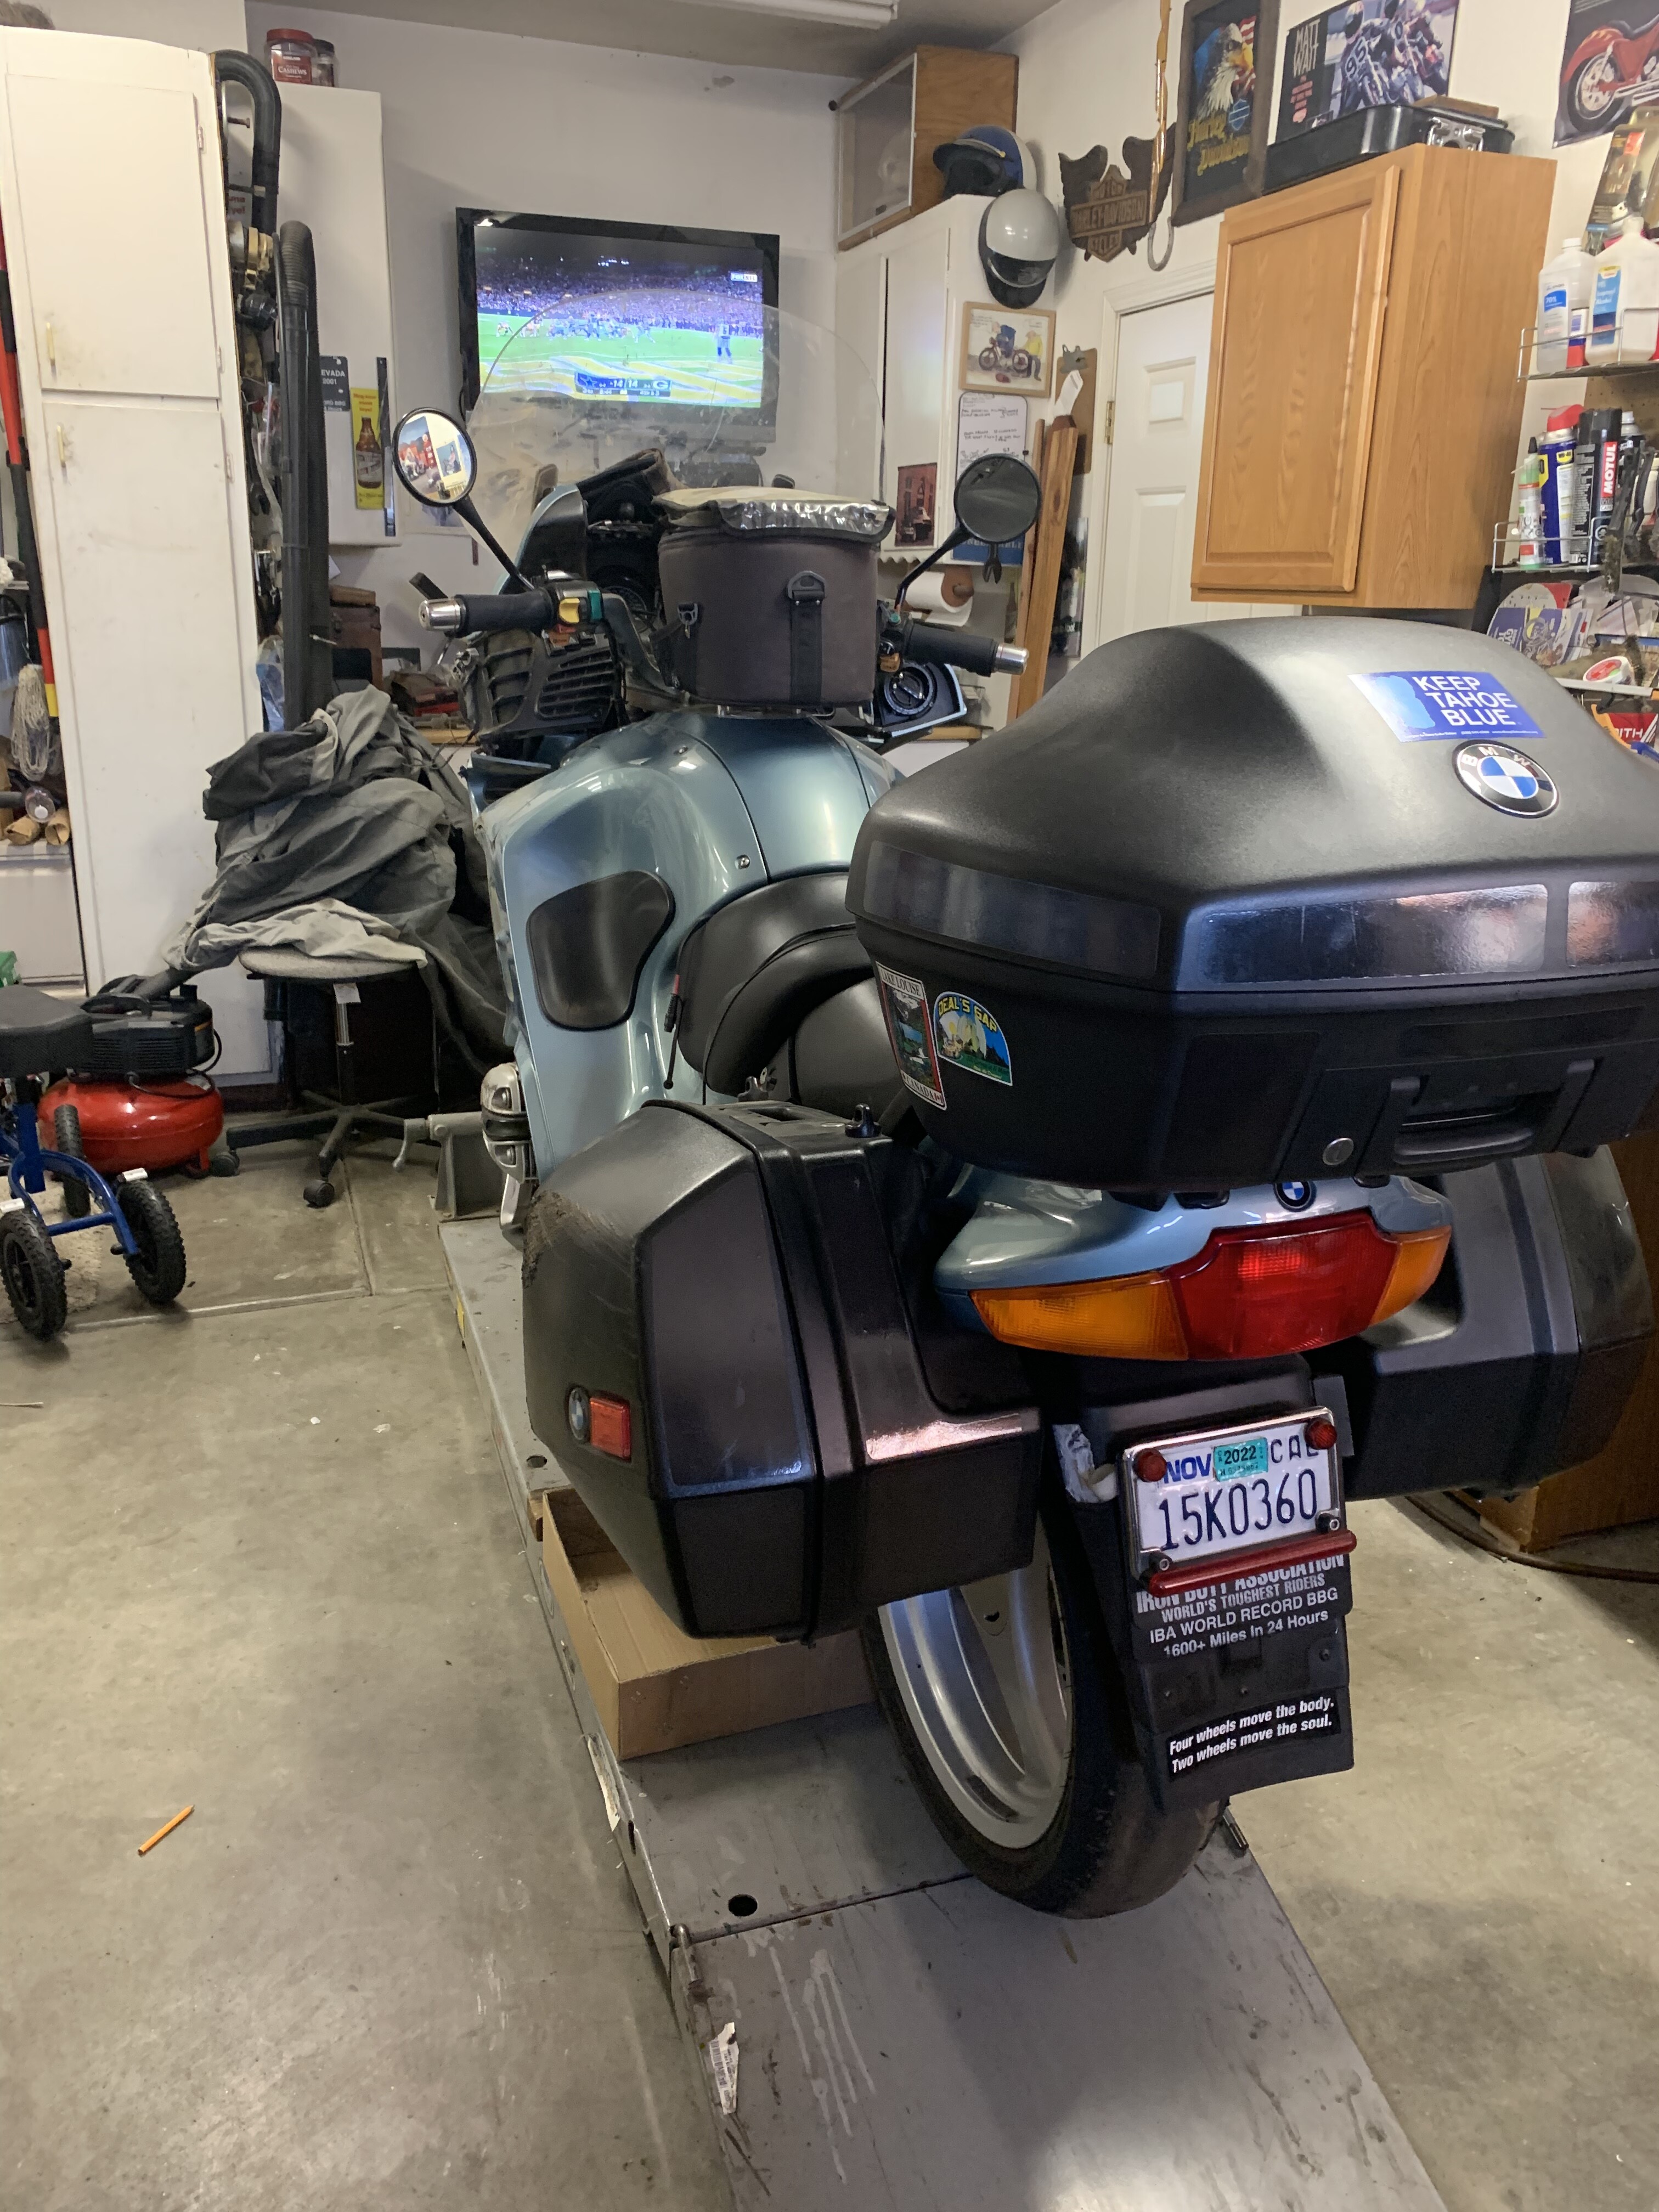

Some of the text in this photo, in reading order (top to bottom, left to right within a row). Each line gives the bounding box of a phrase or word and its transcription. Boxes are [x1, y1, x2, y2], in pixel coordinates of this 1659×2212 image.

[1296, 18, 1320, 53] MATT
[320, 369, 346, 377] EVADA
[1604, 444, 1616, 494] MOTUL
[1412, 675, 1481, 691] KEEP
[1425, 692, 1519, 709] TAHOE
[1440, 709, 1516, 727] BLUE
[1461, 746, 1530, 767] BMW
[895, 977, 921, 996] LOUISE
[938, 996, 997, 1032] DEAL'S GAP
[906, 1075, 934, 1098] CANADA
[1164, 1453, 1212, 1484] NOV
[1224, 1445, 1257, 1465] 2022
[1159, 1468, 1317, 1551] 15K0360
[1150, 1587, 1339, 1644] IBA WORLD RECORD BBG
[1161, 1572, 1326, 1623] WORLD'S TOUGHEST RIDERS
[1164, 1610, 1329, 1658] 1600+ Miles In 24 Hours
[1169, 1696, 1334, 1756] Four wheels move the body.
[1172, 1713, 1333, 1774] Two wheels move the soul.
